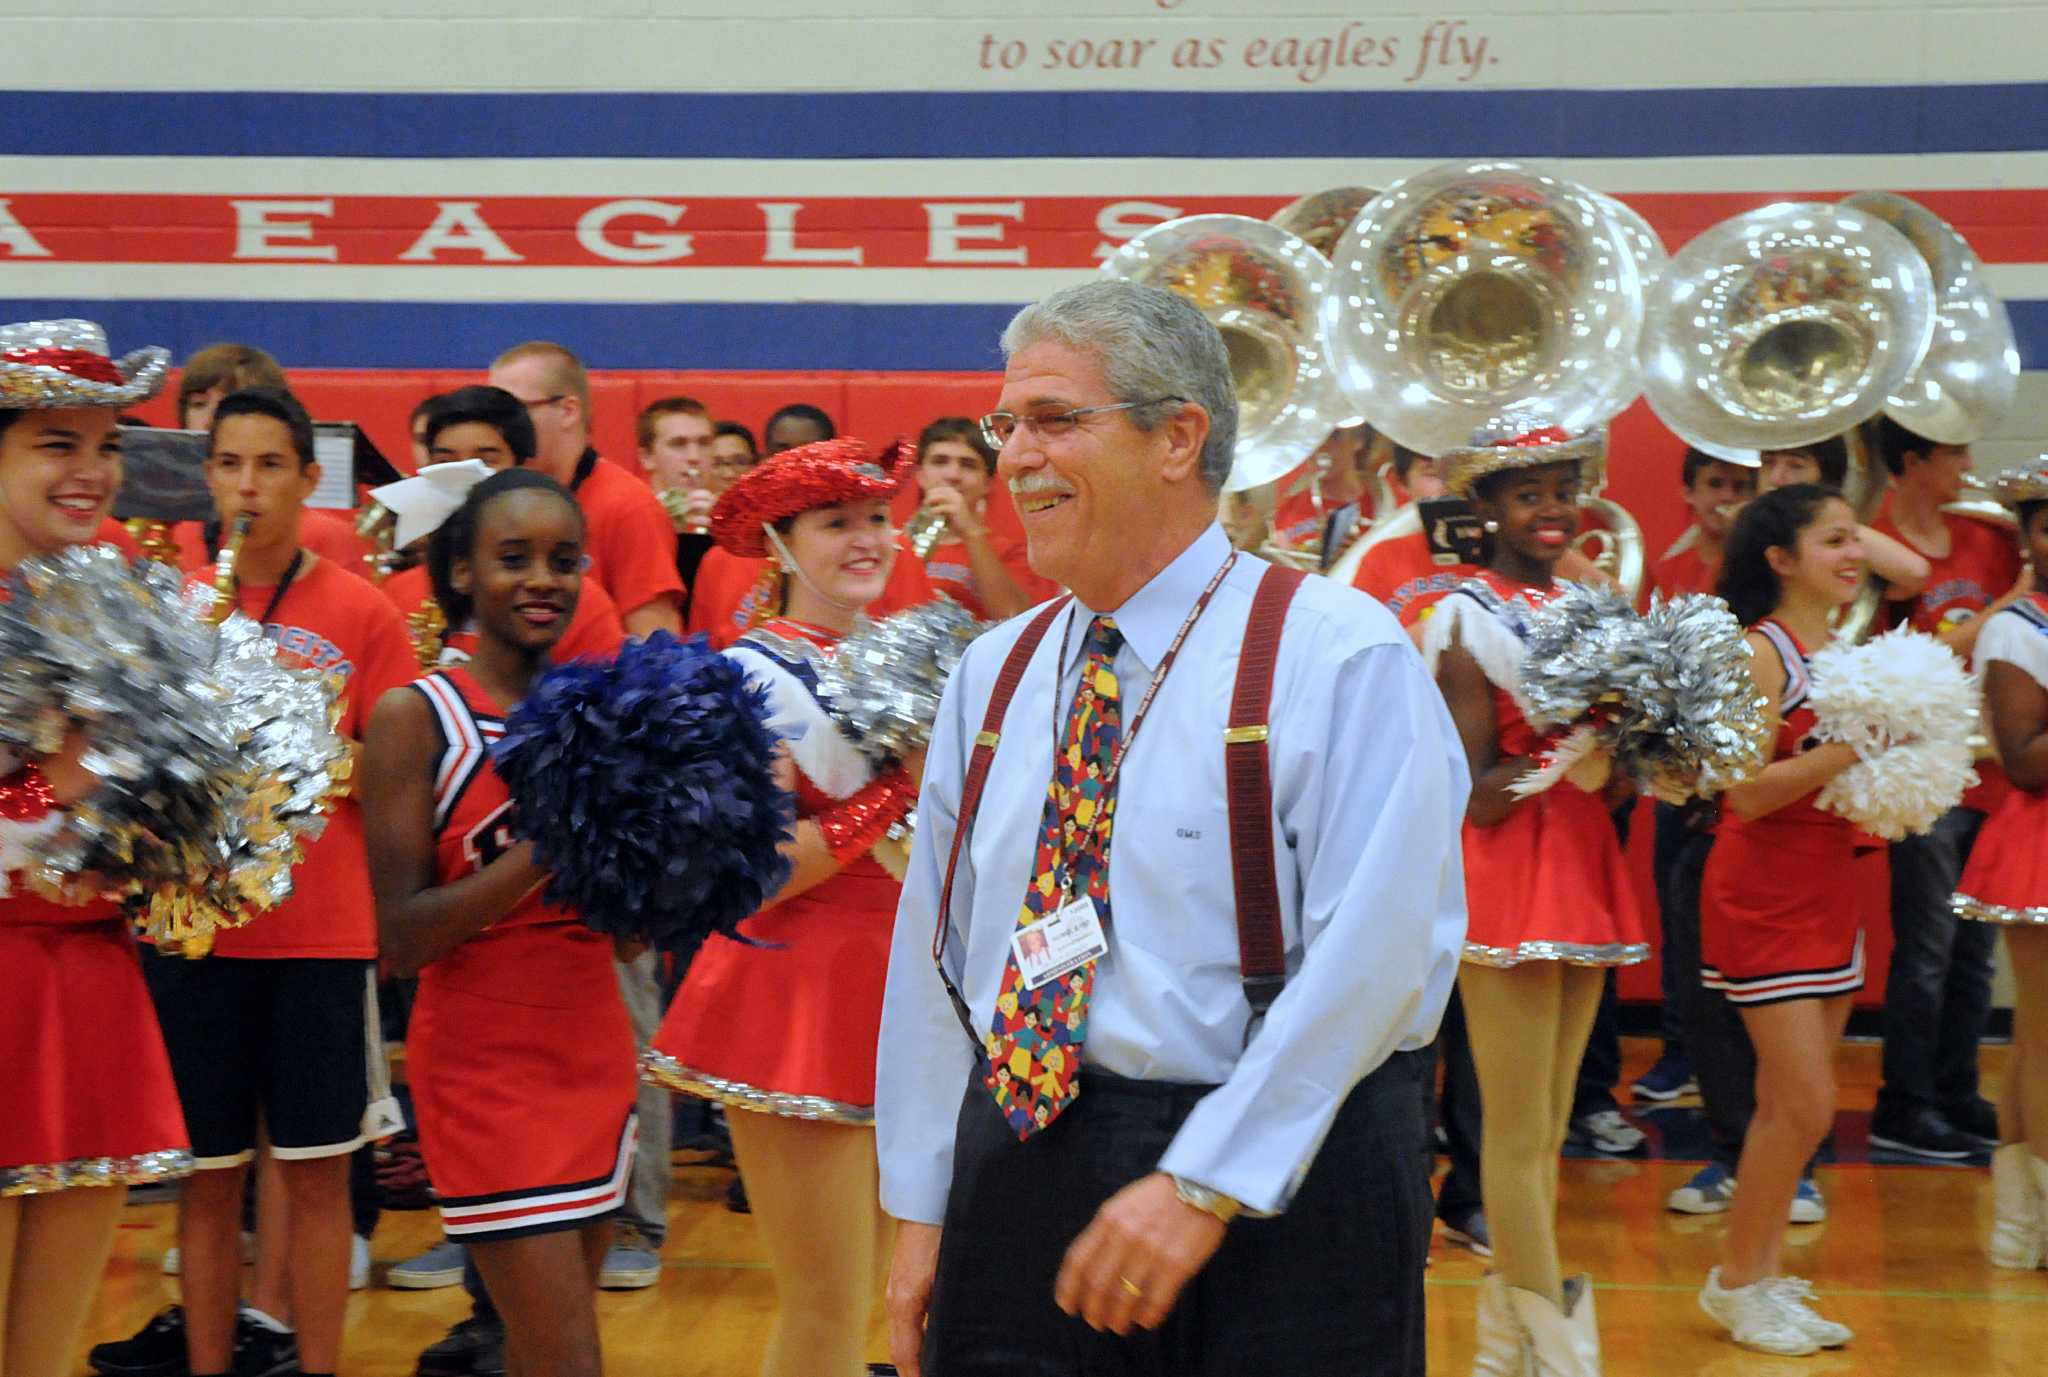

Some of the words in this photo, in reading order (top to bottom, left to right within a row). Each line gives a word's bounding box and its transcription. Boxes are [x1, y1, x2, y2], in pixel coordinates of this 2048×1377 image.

[979, 33, 1028, 69] to
[1041, 37, 1156, 70] soar
[1171, 37, 1226, 69] as
[1243, 22, 1398, 83] eagles
[1403, 20, 1498, 82] fly.
[228, 199, 1184, 262] EAGLES
